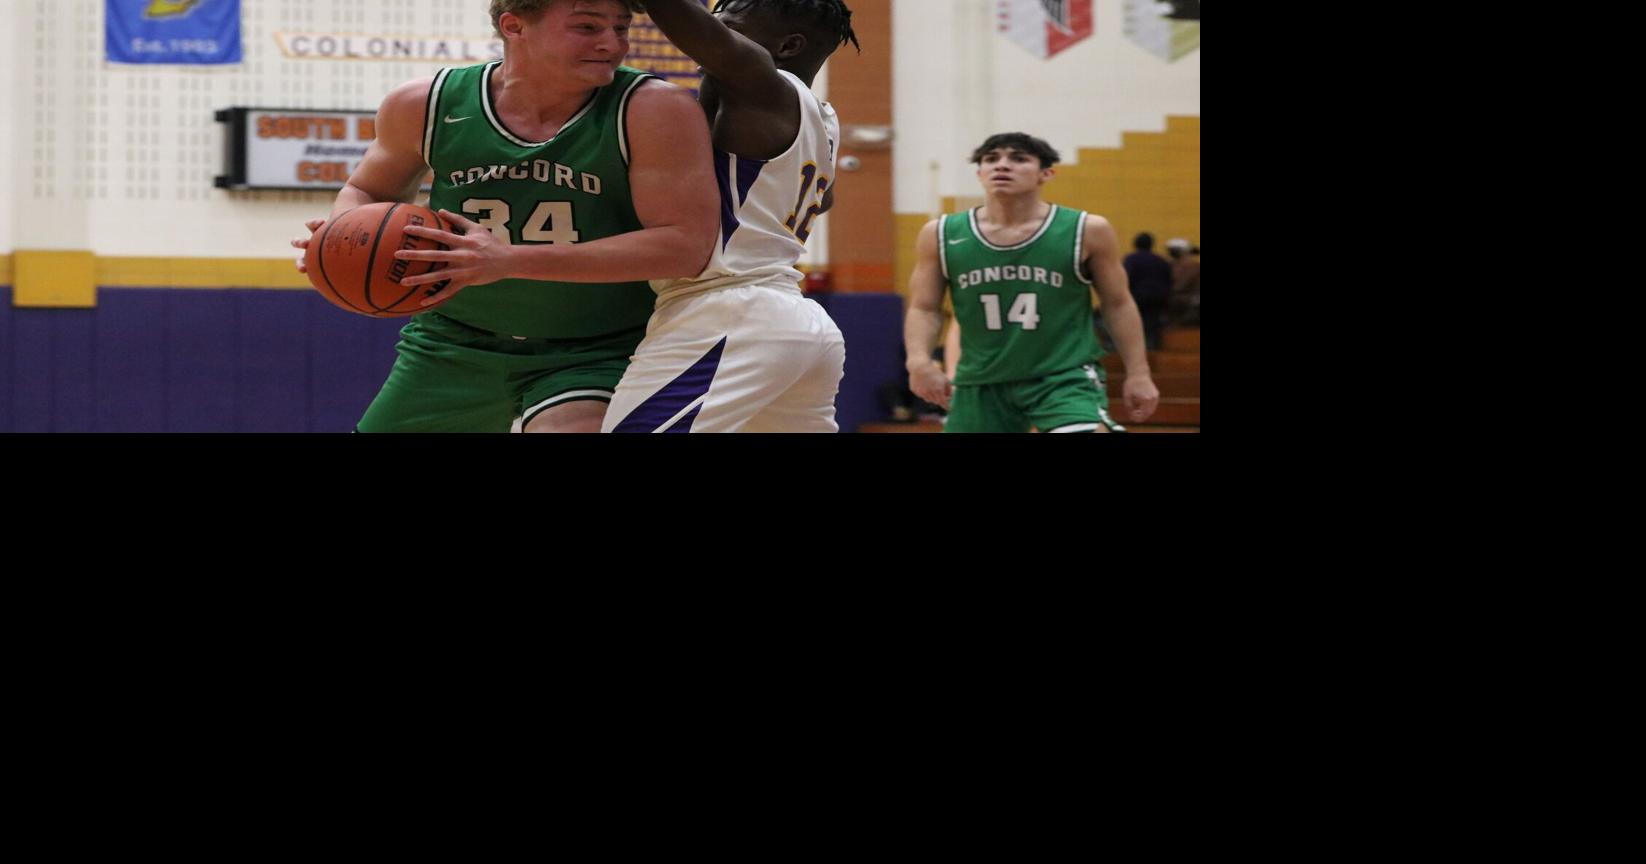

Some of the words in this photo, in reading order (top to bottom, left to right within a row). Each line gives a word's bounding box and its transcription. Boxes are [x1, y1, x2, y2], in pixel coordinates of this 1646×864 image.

[290, 36, 503, 60] COLONIALS
[257, 115, 346, 139] SOUTH
[450, 159, 602, 196] CONCORD
[462, 199, 579, 245] 34
[783, 160, 830, 248] 12
[958, 265, 1063, 289] CONCORD
[980, 293, 1041, 330] 14
